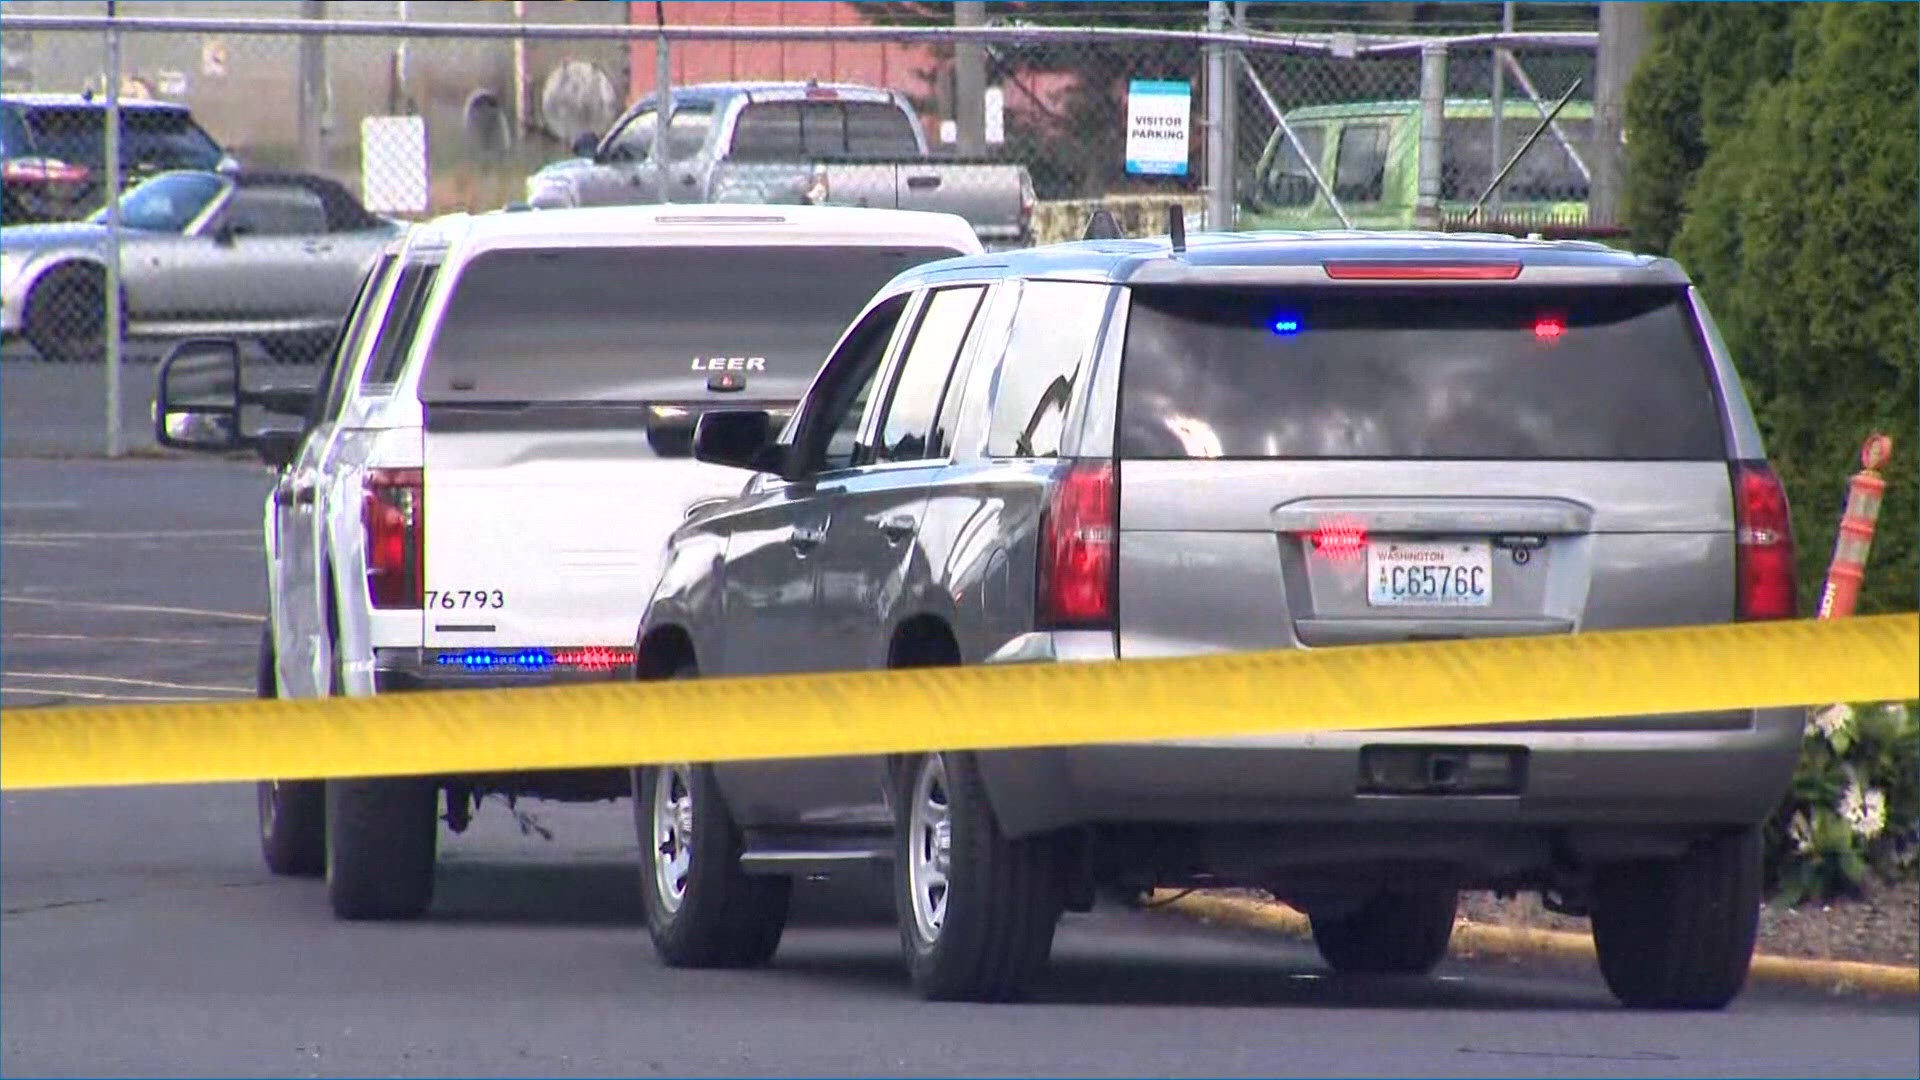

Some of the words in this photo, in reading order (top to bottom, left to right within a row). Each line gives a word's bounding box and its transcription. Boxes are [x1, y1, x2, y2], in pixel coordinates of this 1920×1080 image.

[1135, 116, 1182, 126] VISITOR
[1131, 129, 1184, 140] PARKING
[691, 357, 765, 370] LEER
[1378, 551, 1444, 561] WASHINGTON
[1392, 565, 1484, 596] C6576C
[425, 589, 504, 610] 76793
